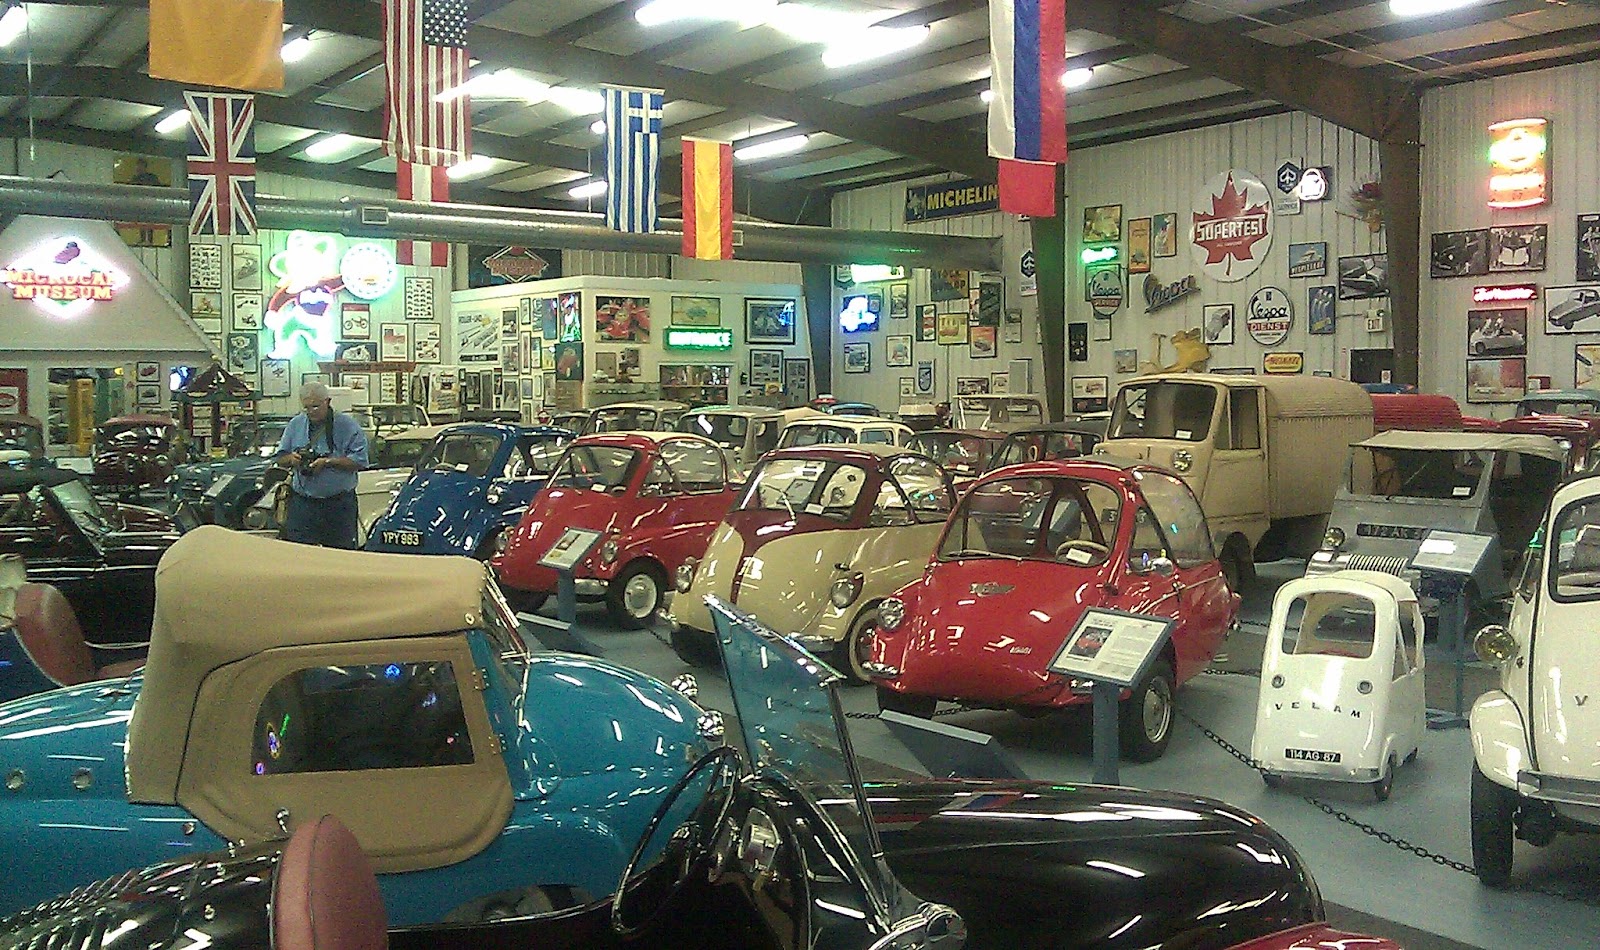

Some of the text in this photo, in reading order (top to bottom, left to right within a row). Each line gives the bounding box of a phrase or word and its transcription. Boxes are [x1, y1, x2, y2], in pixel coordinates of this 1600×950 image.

[927, 184, 998, 211] MICHELIN
[1196, 213, 1266, 241] SUPERTEST
[13, 284, 113, 301] MUSEUM
[1093, 280, 1121, 298] Vespa
[1248, 295, 1288, 321] Vespa
[1250, 322, 1288, 331] DIENST
[382, 531, 400, 545] YPY
[1274, 701, 1361, 719] VELAM
[1289, 749, 1337, 763] 114 AG 87
